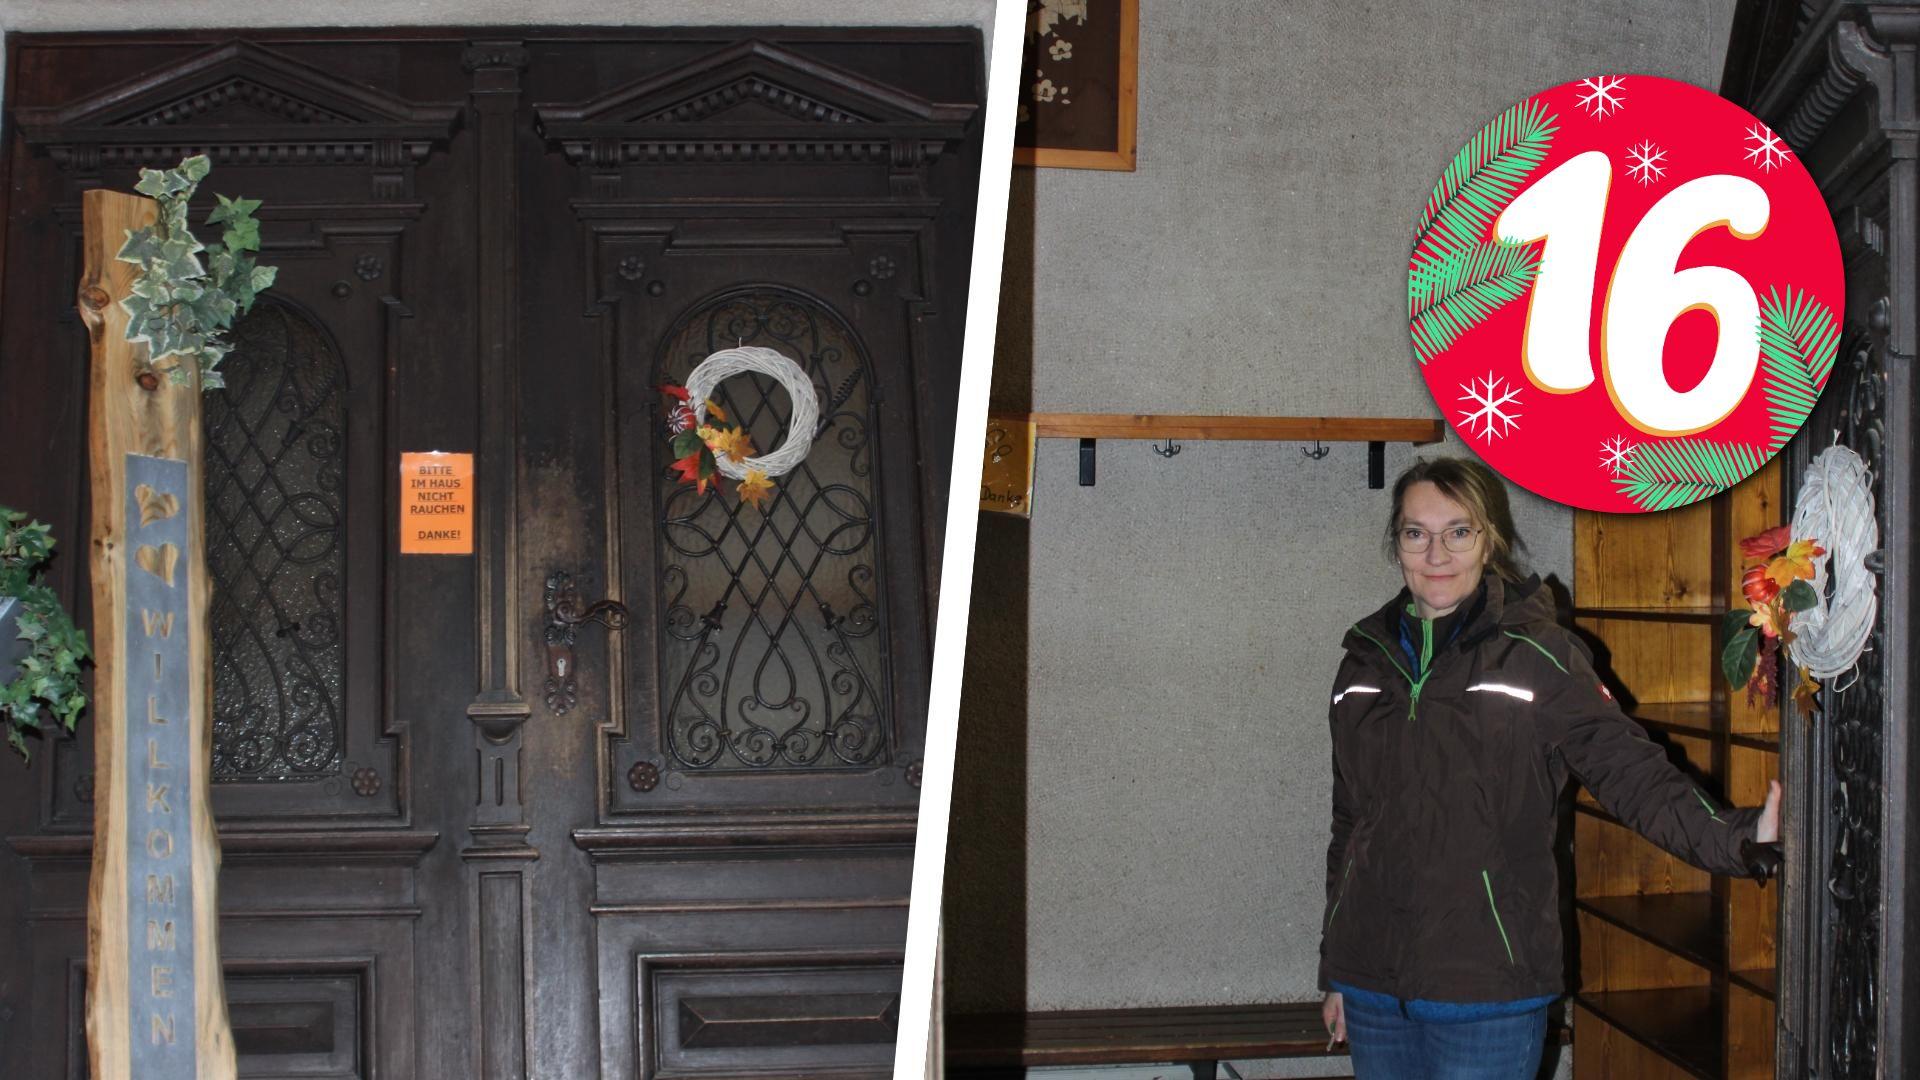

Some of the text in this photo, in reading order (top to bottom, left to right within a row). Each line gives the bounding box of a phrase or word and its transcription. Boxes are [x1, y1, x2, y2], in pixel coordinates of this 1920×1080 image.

[419, 466, 453, 475] BITTE
[411, 479, 461, 488] IM HAUS
[417, 491, 454, 501] NICHT
[410, 504, 465, 514] RAUCHEN
[418, 530, 461, 540] DANKE!
[141, 608, 175, 1047] WILLKOMMEN
